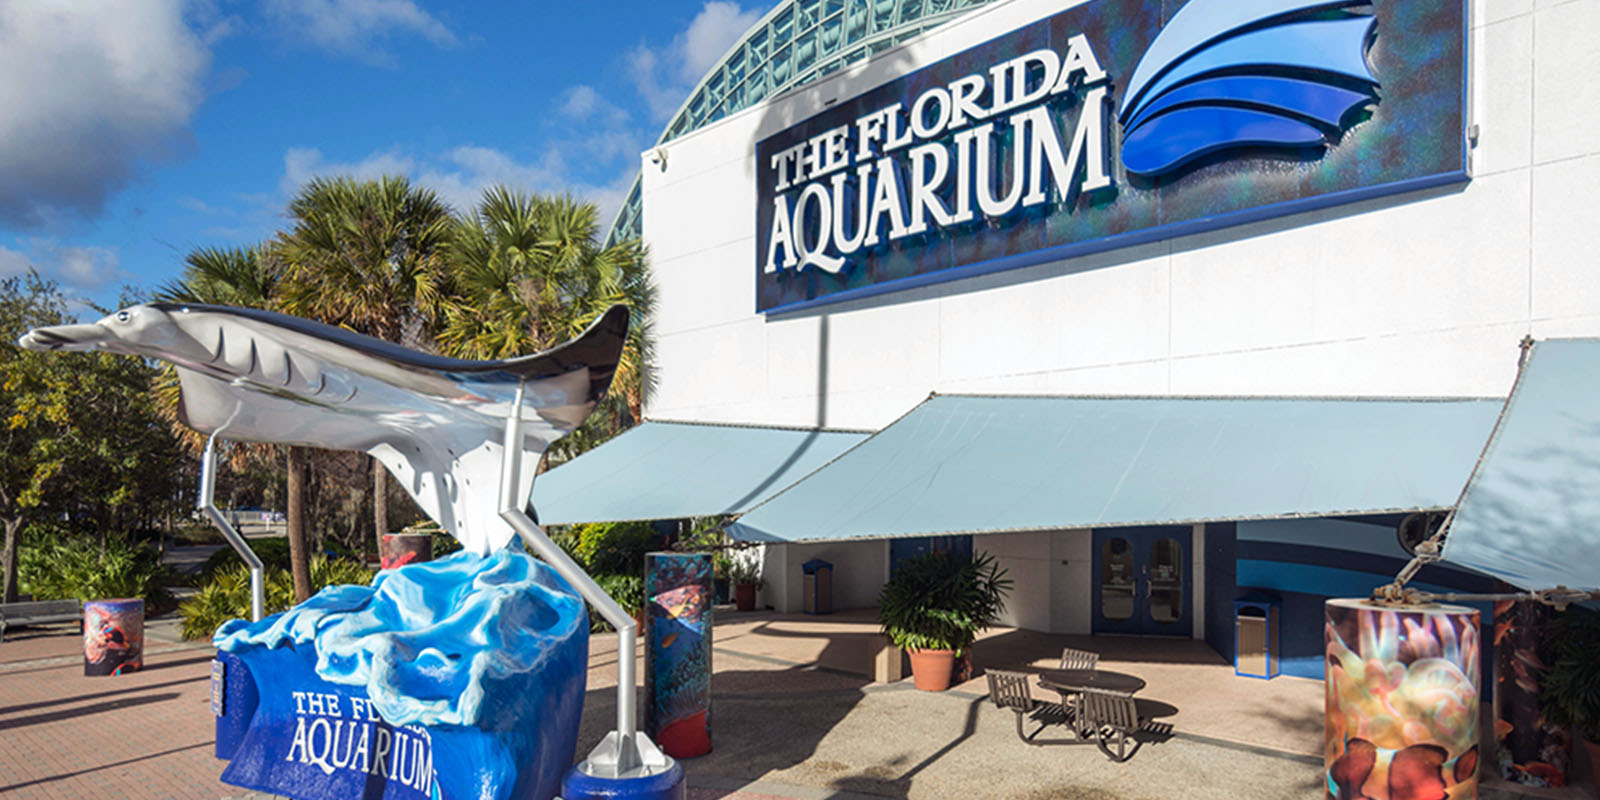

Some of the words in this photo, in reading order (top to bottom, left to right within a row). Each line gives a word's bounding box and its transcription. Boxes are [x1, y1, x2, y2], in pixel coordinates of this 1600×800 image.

[772, 125, 849, 191] THE
[856, 33, 1107, 161] FLORIDA
[764, 86, 1111, 273] AQUARIUM
[287, 717, 432, 797] AQUARIUM
[292, 691, 342, 717] THE
